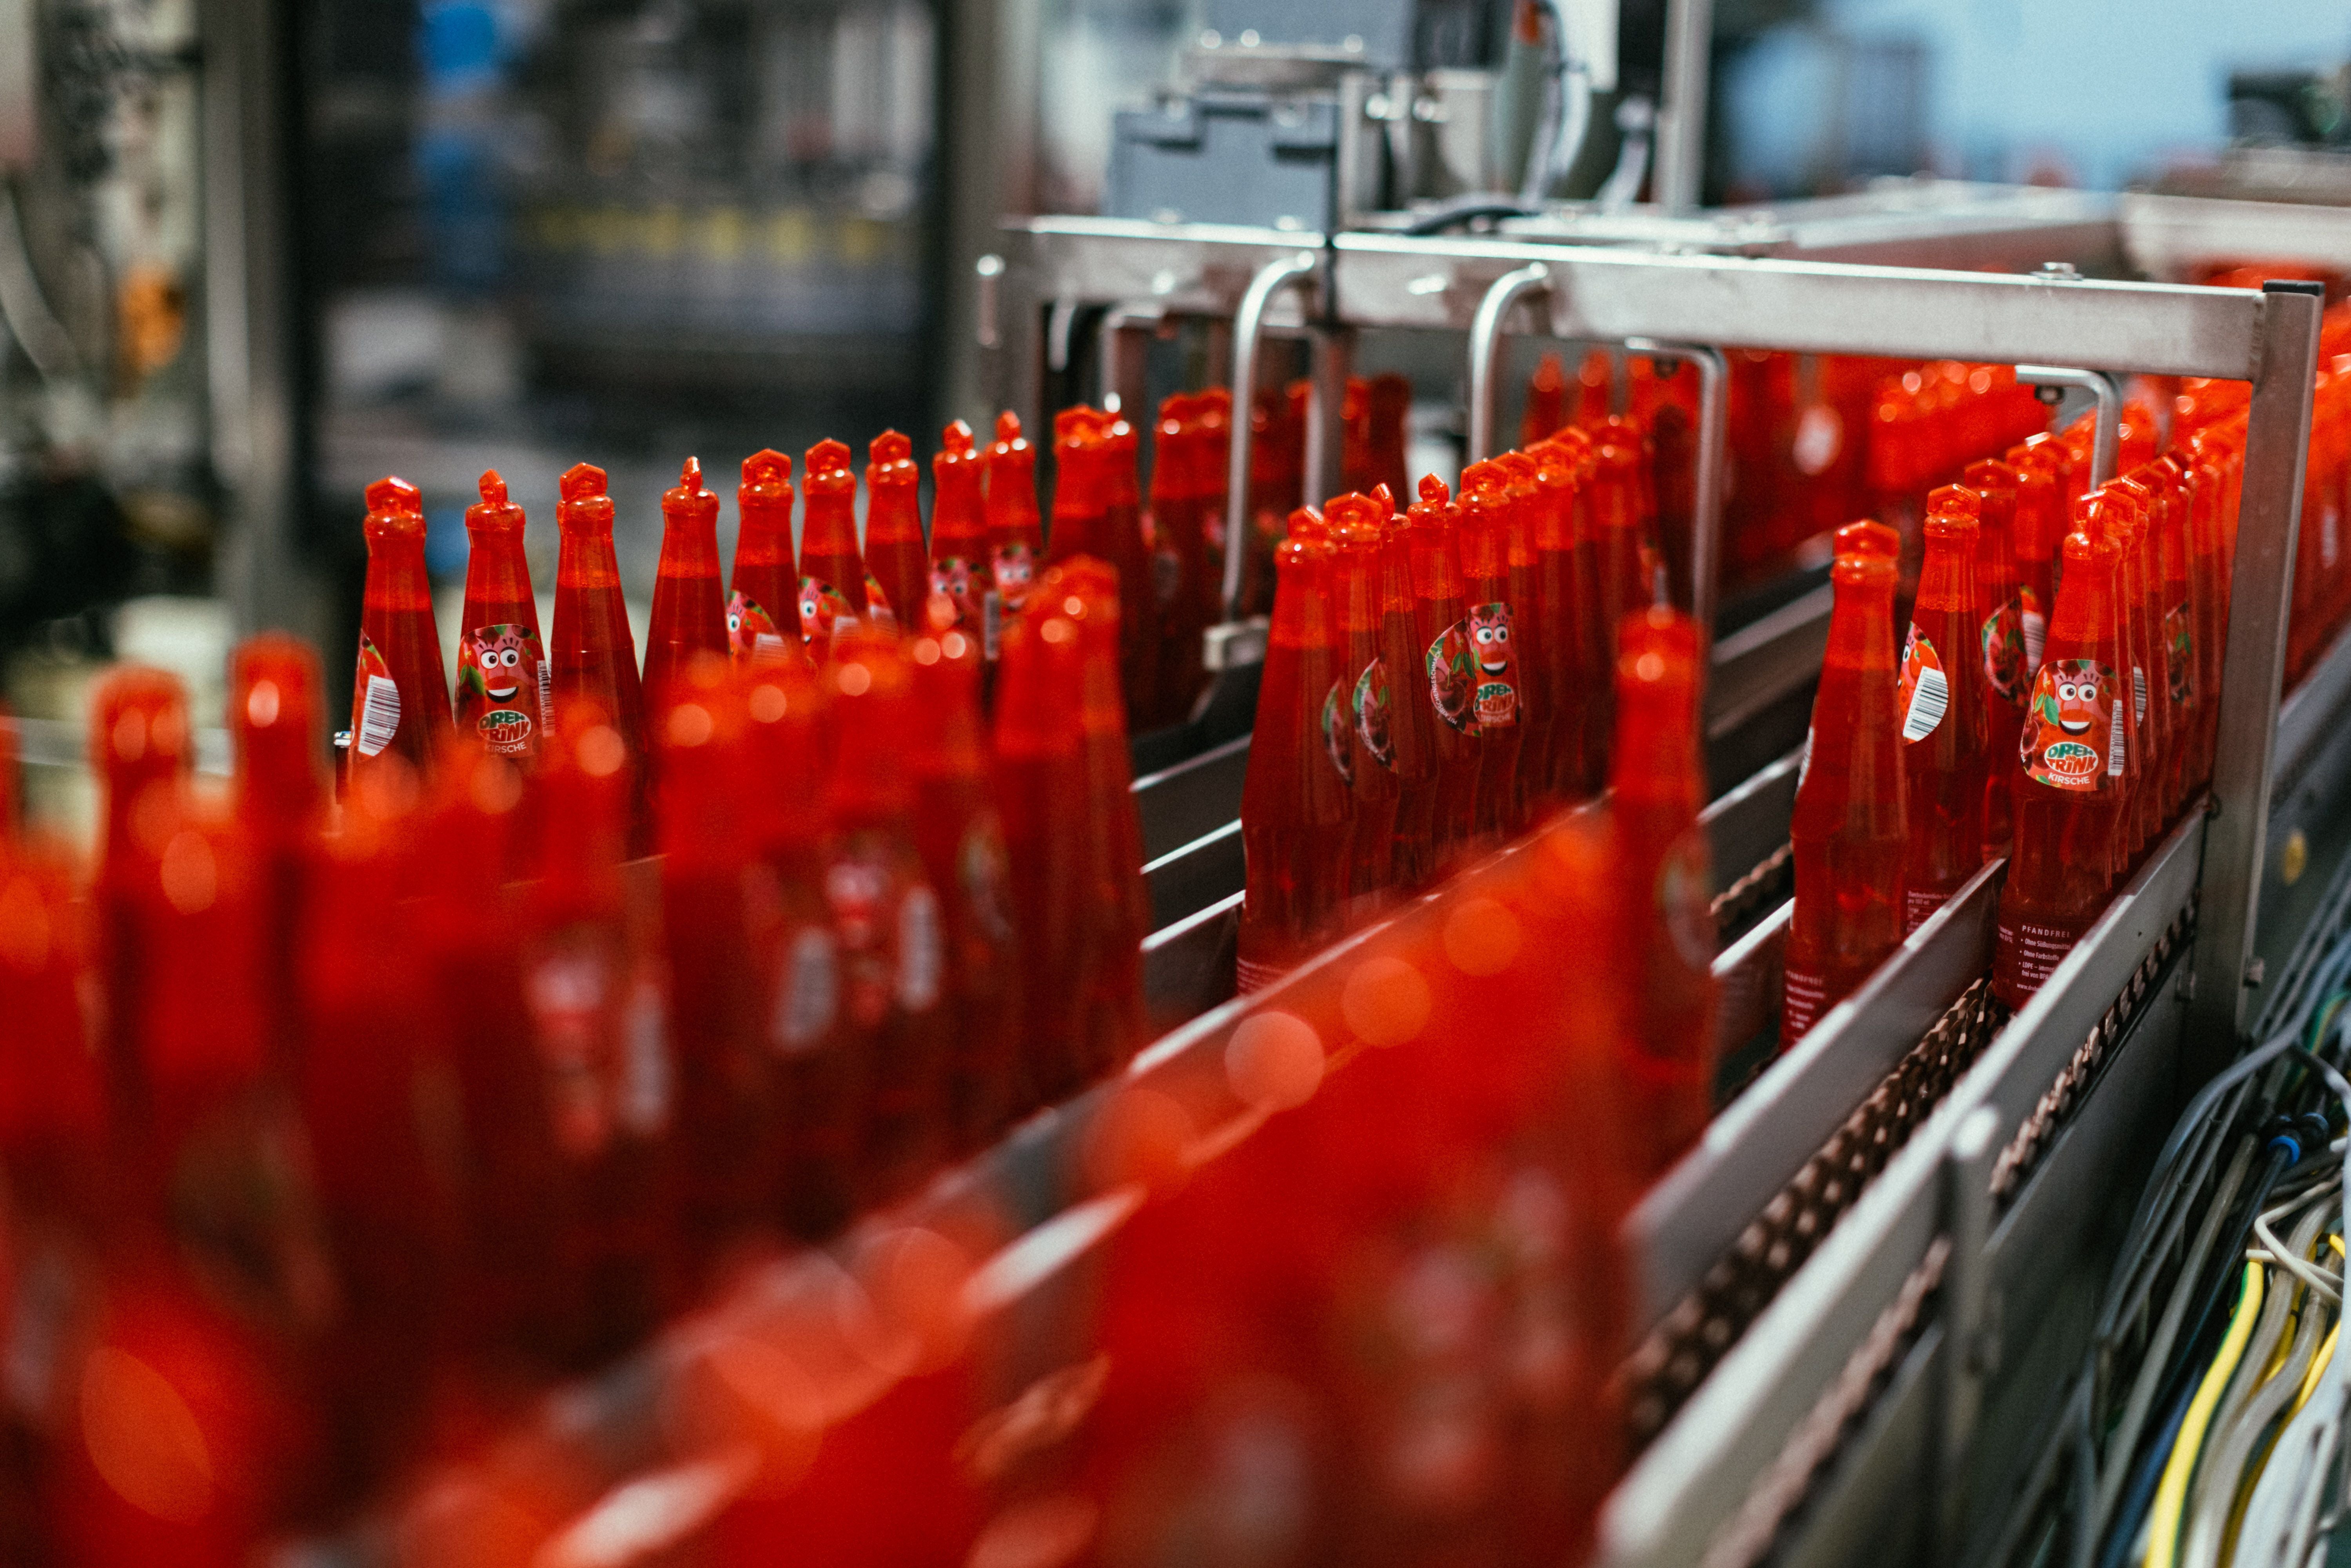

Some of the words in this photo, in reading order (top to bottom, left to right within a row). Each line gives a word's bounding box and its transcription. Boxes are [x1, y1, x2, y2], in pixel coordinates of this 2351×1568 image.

[479, 711, 525, 729] DREH
[1447, 716, 1458, 725] MIT
[2048, 744, 2093, 758] DREH
[2046, 756, 2097, 773] TRINK
[2048, 772, 2090, 785] KIRSCHE
[2022, 925, 2070, 938] PFANDFREI
[2025, 938, 2036, 946] Ohne
[2036, 952, 2059, 960] Farbstoffe
[2017, 983, 2039, 991] www.dreh
